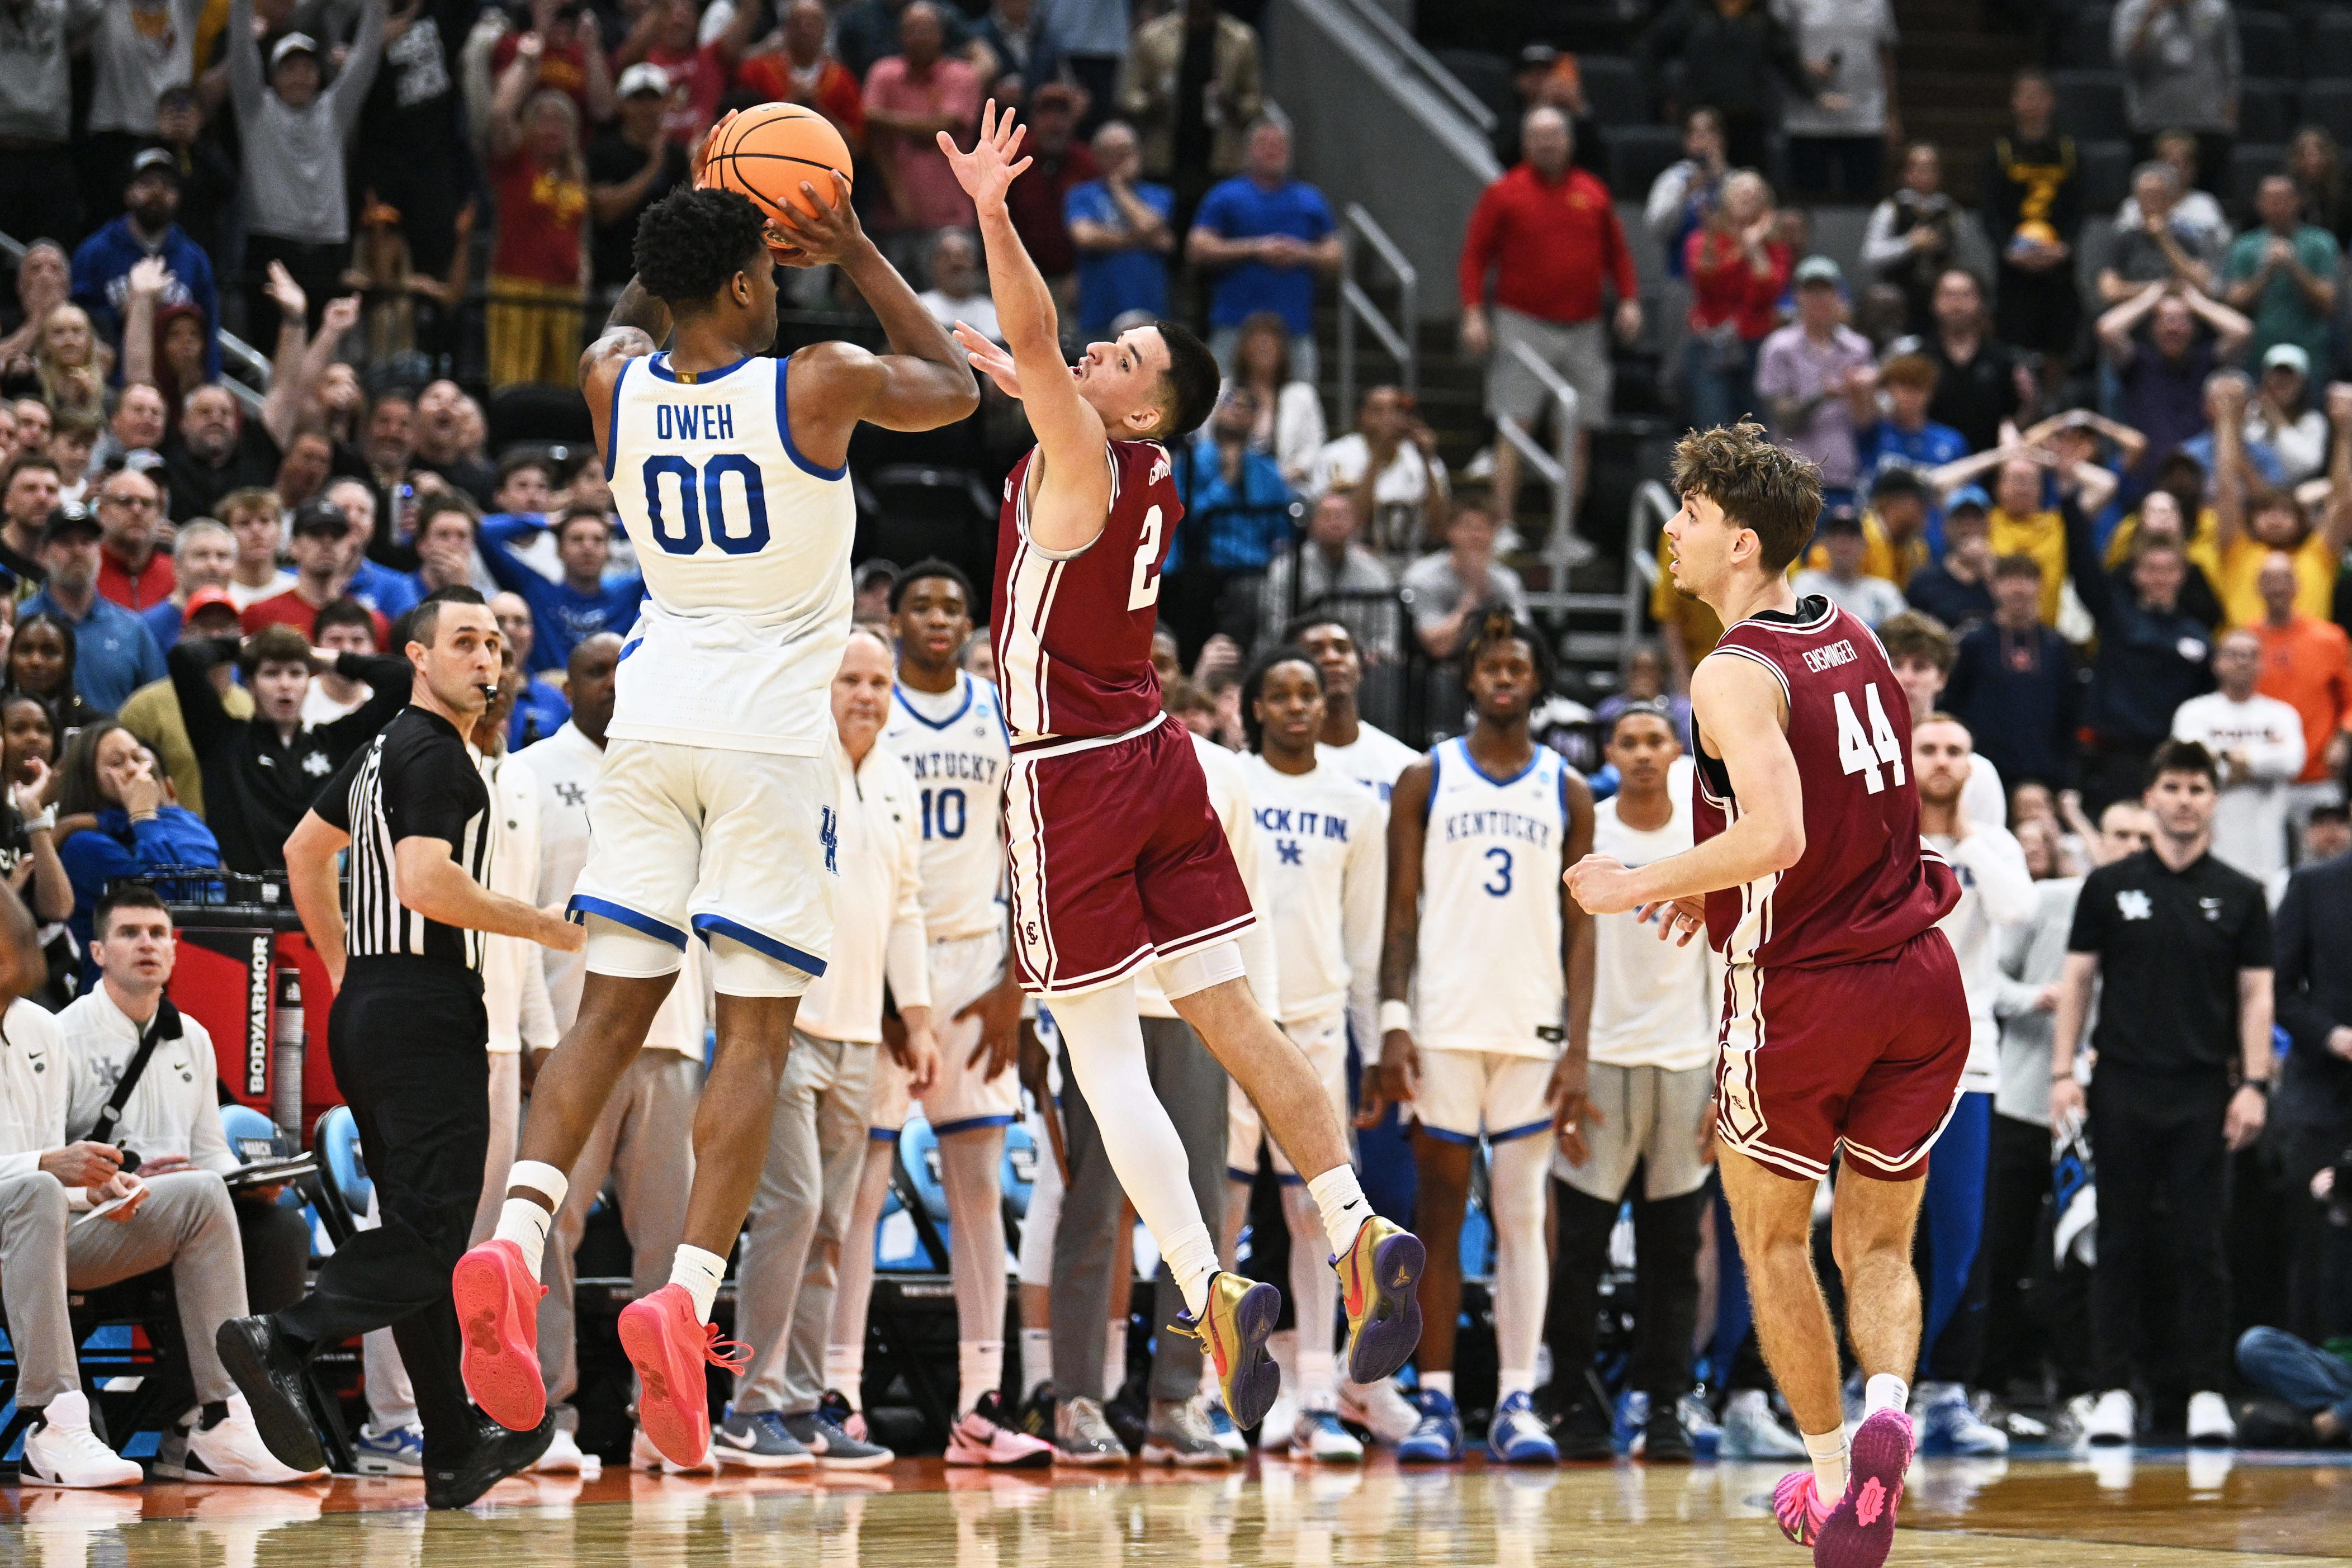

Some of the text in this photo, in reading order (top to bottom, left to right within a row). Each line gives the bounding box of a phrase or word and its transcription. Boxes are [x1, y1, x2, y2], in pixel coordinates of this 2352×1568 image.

[656, 404, 734, 440] OWEH
[642, 453, 771, 555] 00
[1127, 504, 1163, 612] 2
[1801, 638, 1858, 674] ENSMINGER
[1833, 682, 1906, 795] 44
[901, 751, 997, 785] NTUCKY
[921, 788, 966, 840] 10
[1299, 812, 1318, 833] IT
[1446, 810, 1549, 849] KENTUCKY
[1483, 846, 1513, 898] 3
[249, 936, 268, 1094] BODYARMOR
